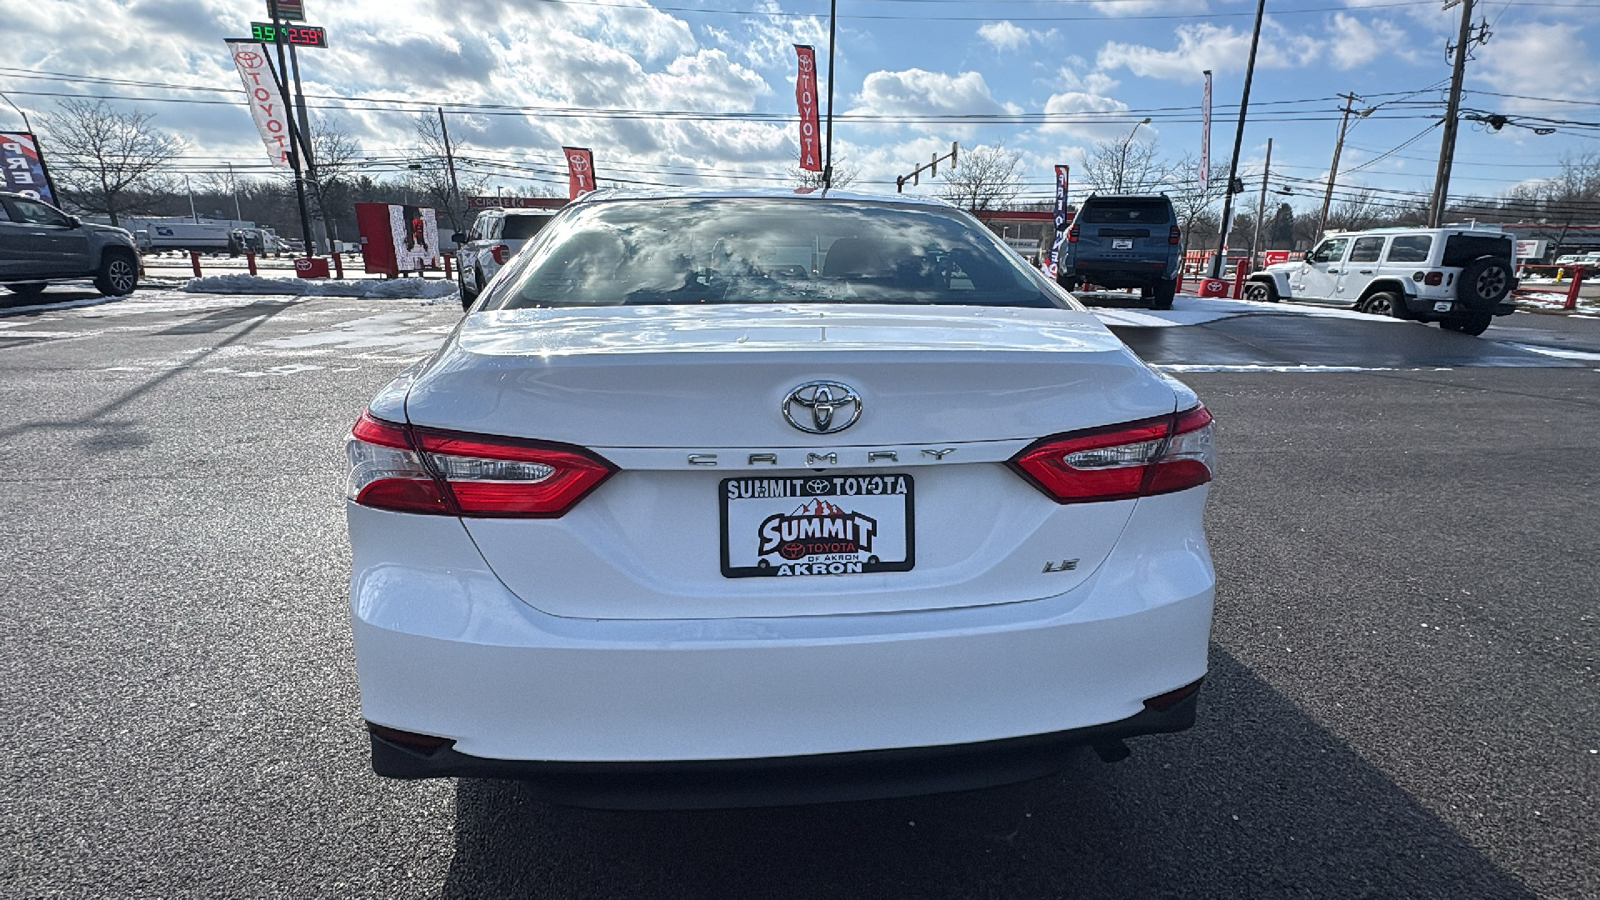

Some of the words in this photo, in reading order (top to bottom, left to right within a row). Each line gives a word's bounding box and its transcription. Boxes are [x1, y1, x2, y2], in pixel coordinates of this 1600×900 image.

[802, 74, 815, 166] TOYOTA
[687, 447, 957, 467] CAMRY
[727, 479, 804, 499] SUMMIT
[832, 476, 908, 496] TOYOTA
[762, 516, 873, 552] SUMMIT
[806, 542, 856, 554] TOYOTA
[807, 554, 820, 563] OF
[824, 553, 860, 562] AKRON
[1041, 558, 1081, 573] LE
[776, 561, 863, 577] AKRON
